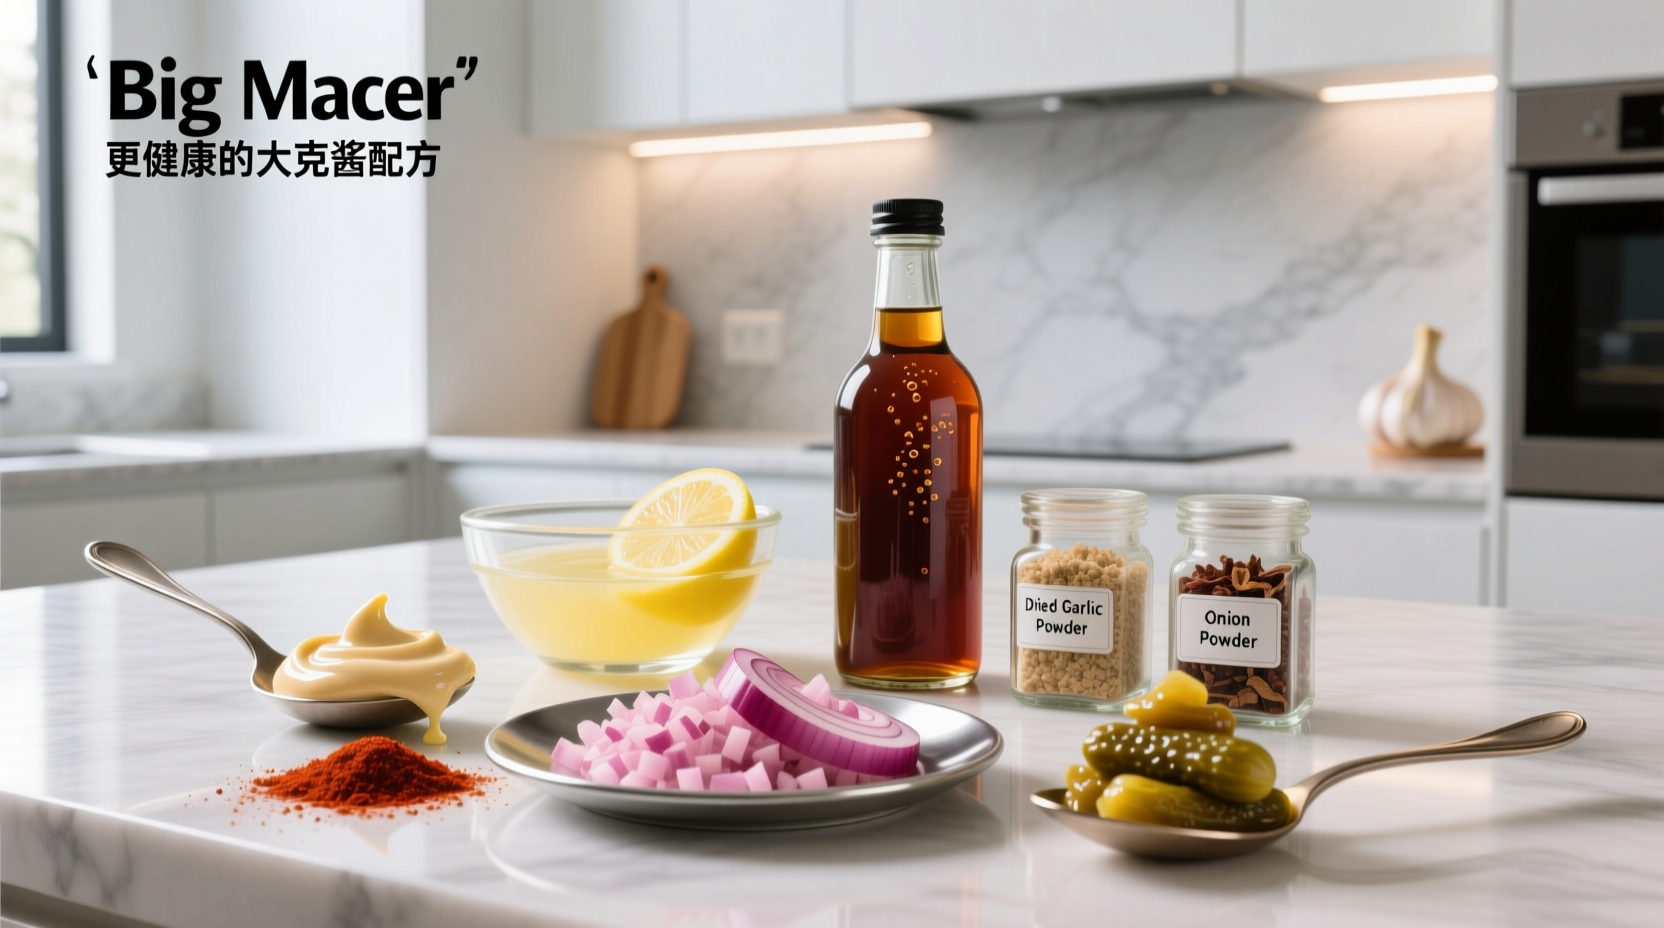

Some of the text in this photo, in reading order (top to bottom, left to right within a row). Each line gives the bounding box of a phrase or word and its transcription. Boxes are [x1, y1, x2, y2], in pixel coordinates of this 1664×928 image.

[1062, 599, 1104, 616] Garlic
[1036, 618, 1088, 636] Powder
[1204, 609, 1251, 627] Onion
[1200, 630, 1258, 649] Powder
